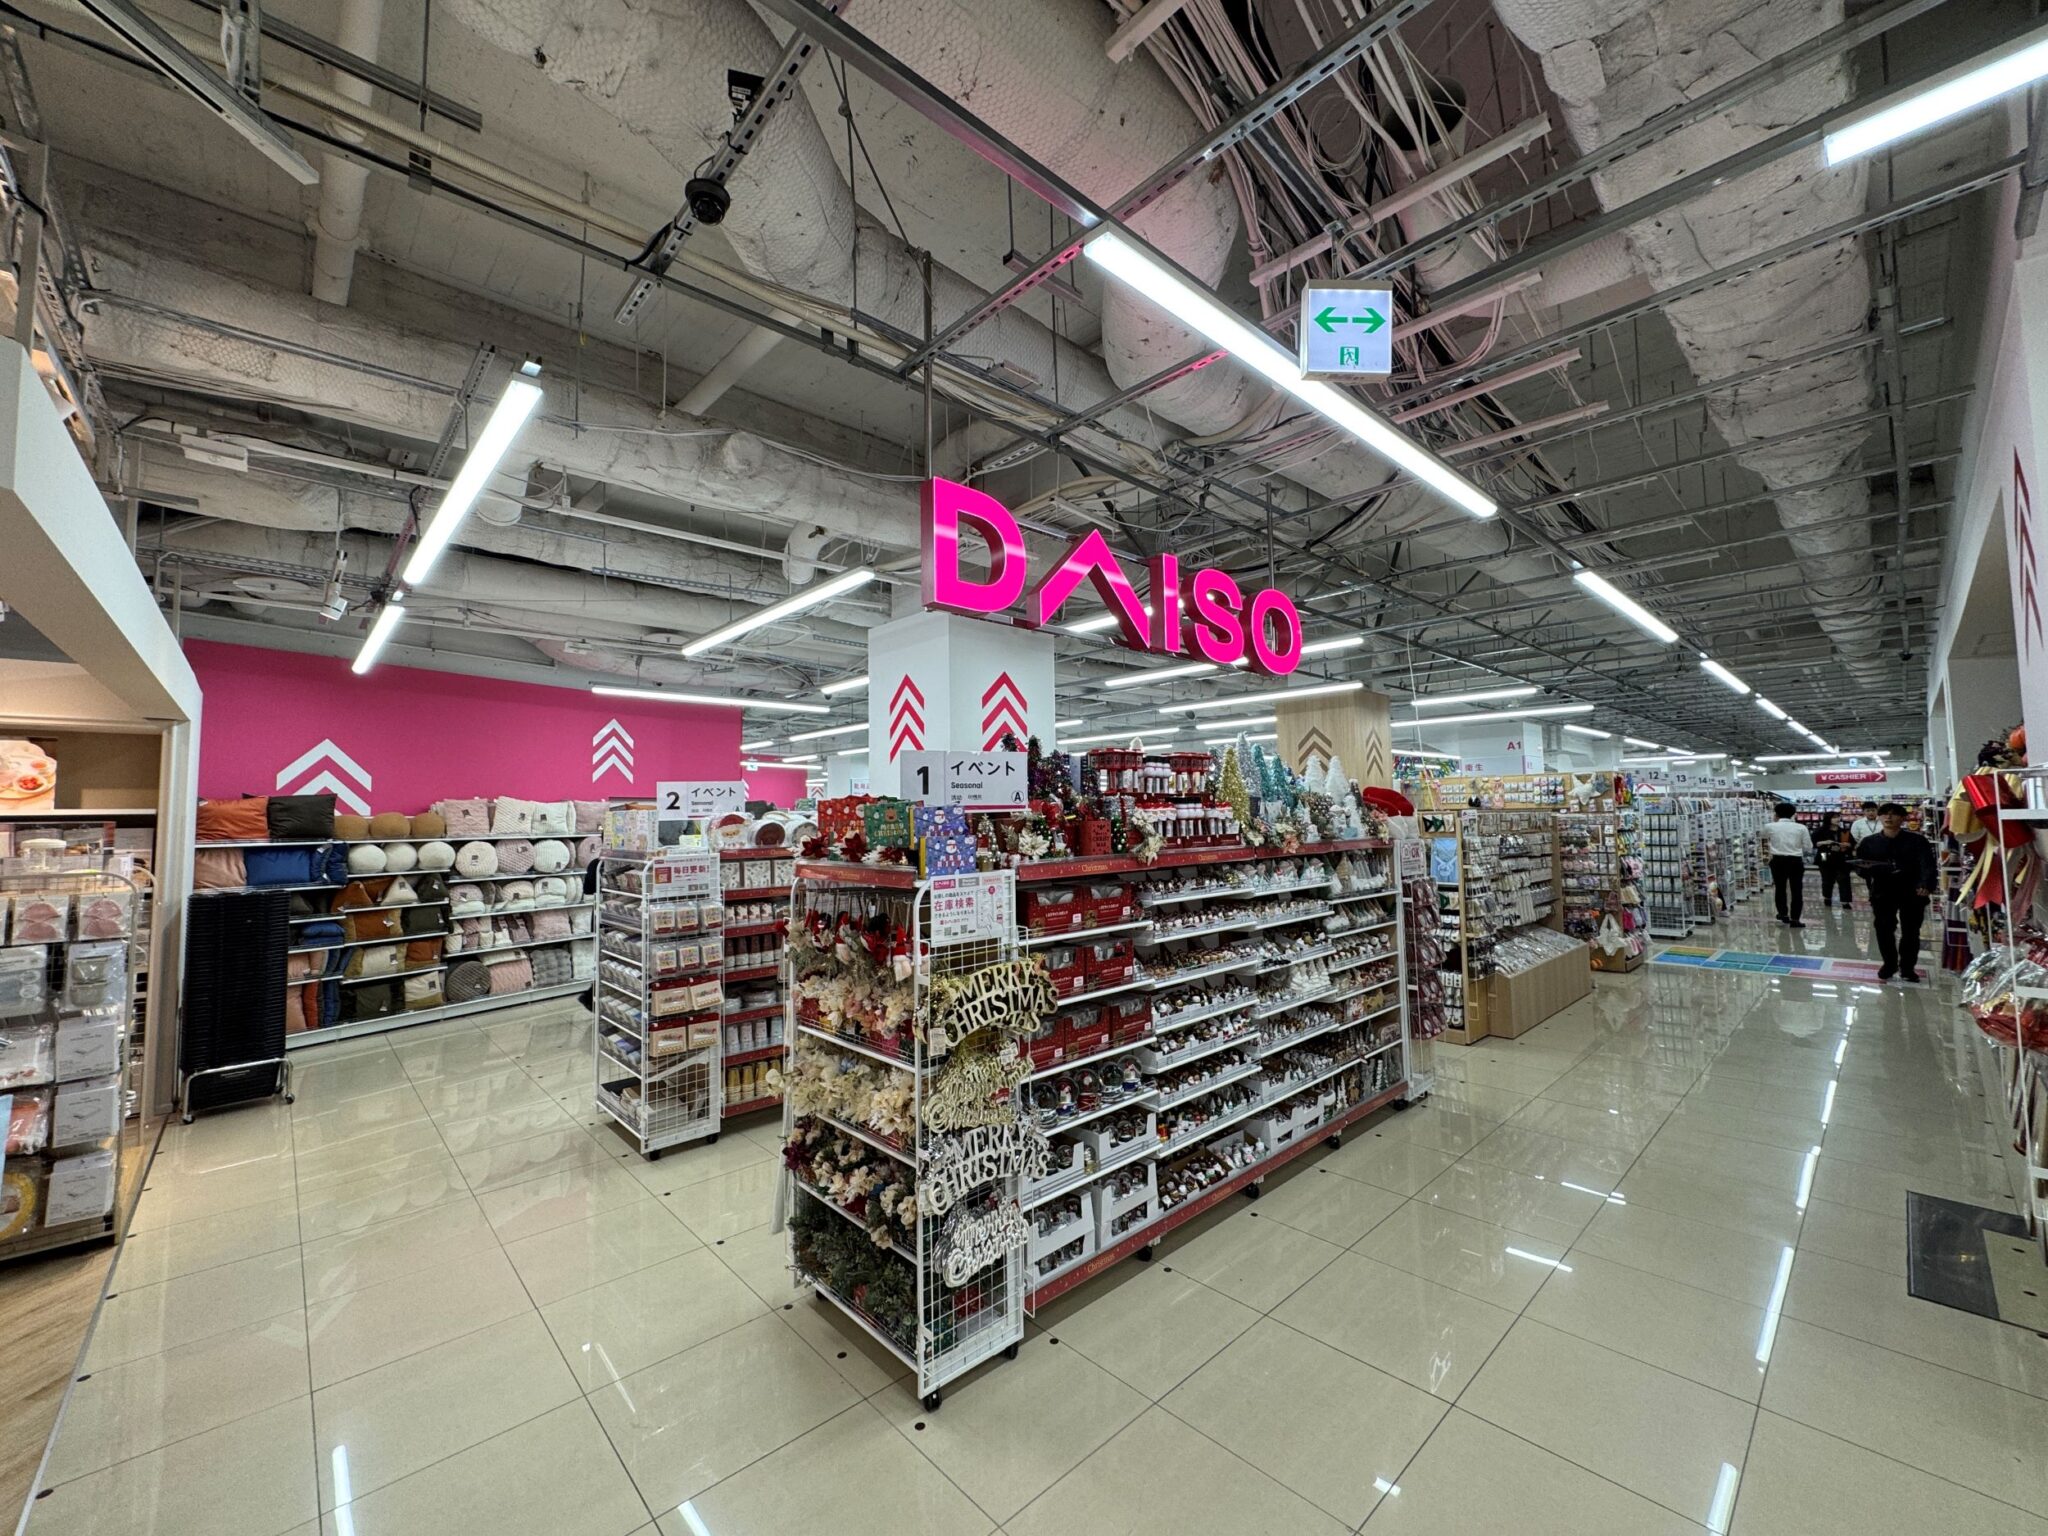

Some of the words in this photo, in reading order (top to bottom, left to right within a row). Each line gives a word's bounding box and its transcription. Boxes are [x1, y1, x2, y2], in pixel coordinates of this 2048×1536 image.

[923, 476, 1302, 675] DAISO
[1507, 741, 1521, 750] A1
[951, 761, 1015, 776] イベント
[917, 766, 929, 795] 1
[1649, 772, 1659, 780] 12
[1676, 774, 1687, 782] 13
[1699, 776, 1707, 784] 14
[691, 787, 736, 797] イベント
[1014, 792, 1022, 802] A
[666, 791, 680, 810] 2
[1411, 847, 1421, 858] OK
[934, 897, 974, 911] 在庫検索
[958, 959, 1034, 1006] MERRY
[945, 987, 1059, 1047] CHRISTMAS
[951, 1121, 1029, 1163] MERRY
[929, 1150, 1050, 1216] CHRISTMAS
